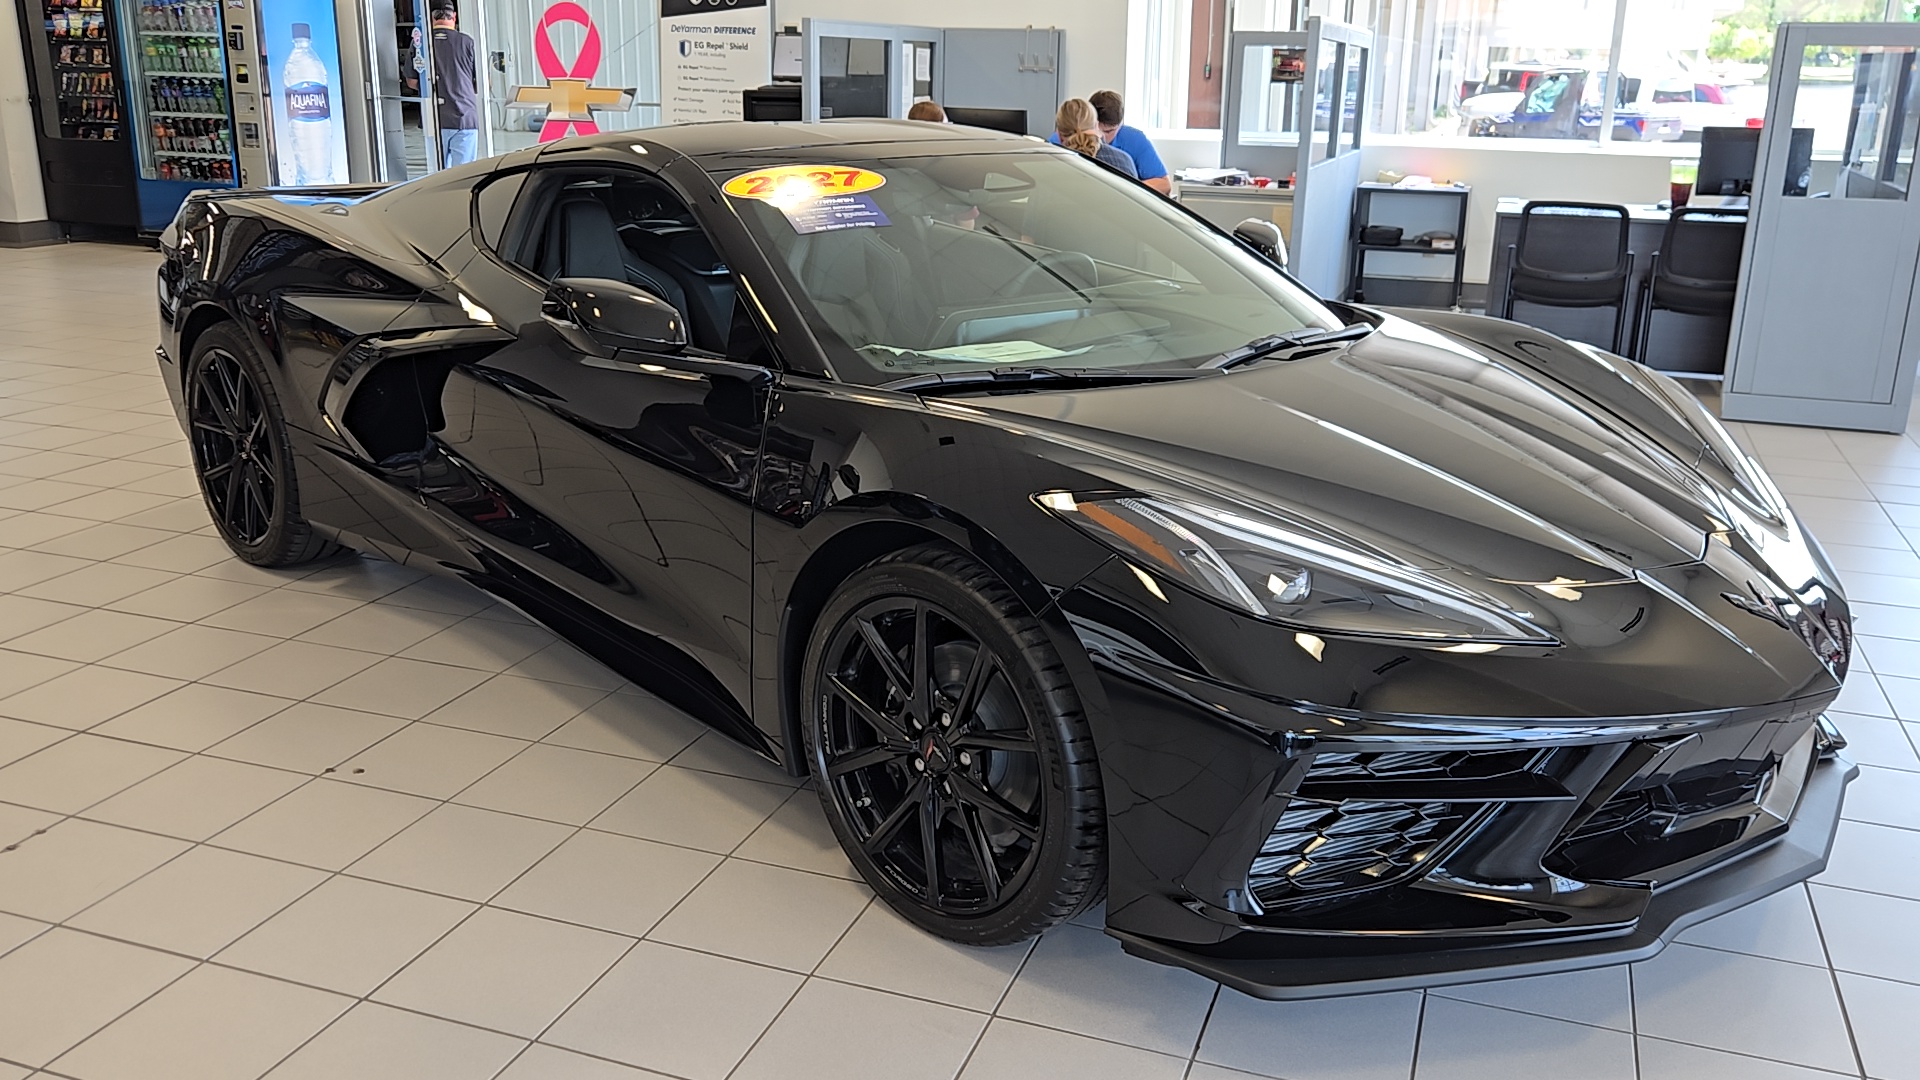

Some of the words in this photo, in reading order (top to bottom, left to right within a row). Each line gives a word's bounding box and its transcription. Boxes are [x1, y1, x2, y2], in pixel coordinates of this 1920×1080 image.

[671, 24, 712, 33] DeYarman
[714, 26, 756, 35] DIFFERENCE
[694, 41, 704, 49] EG
[290, 92, 327, 110] AQUAFINA
